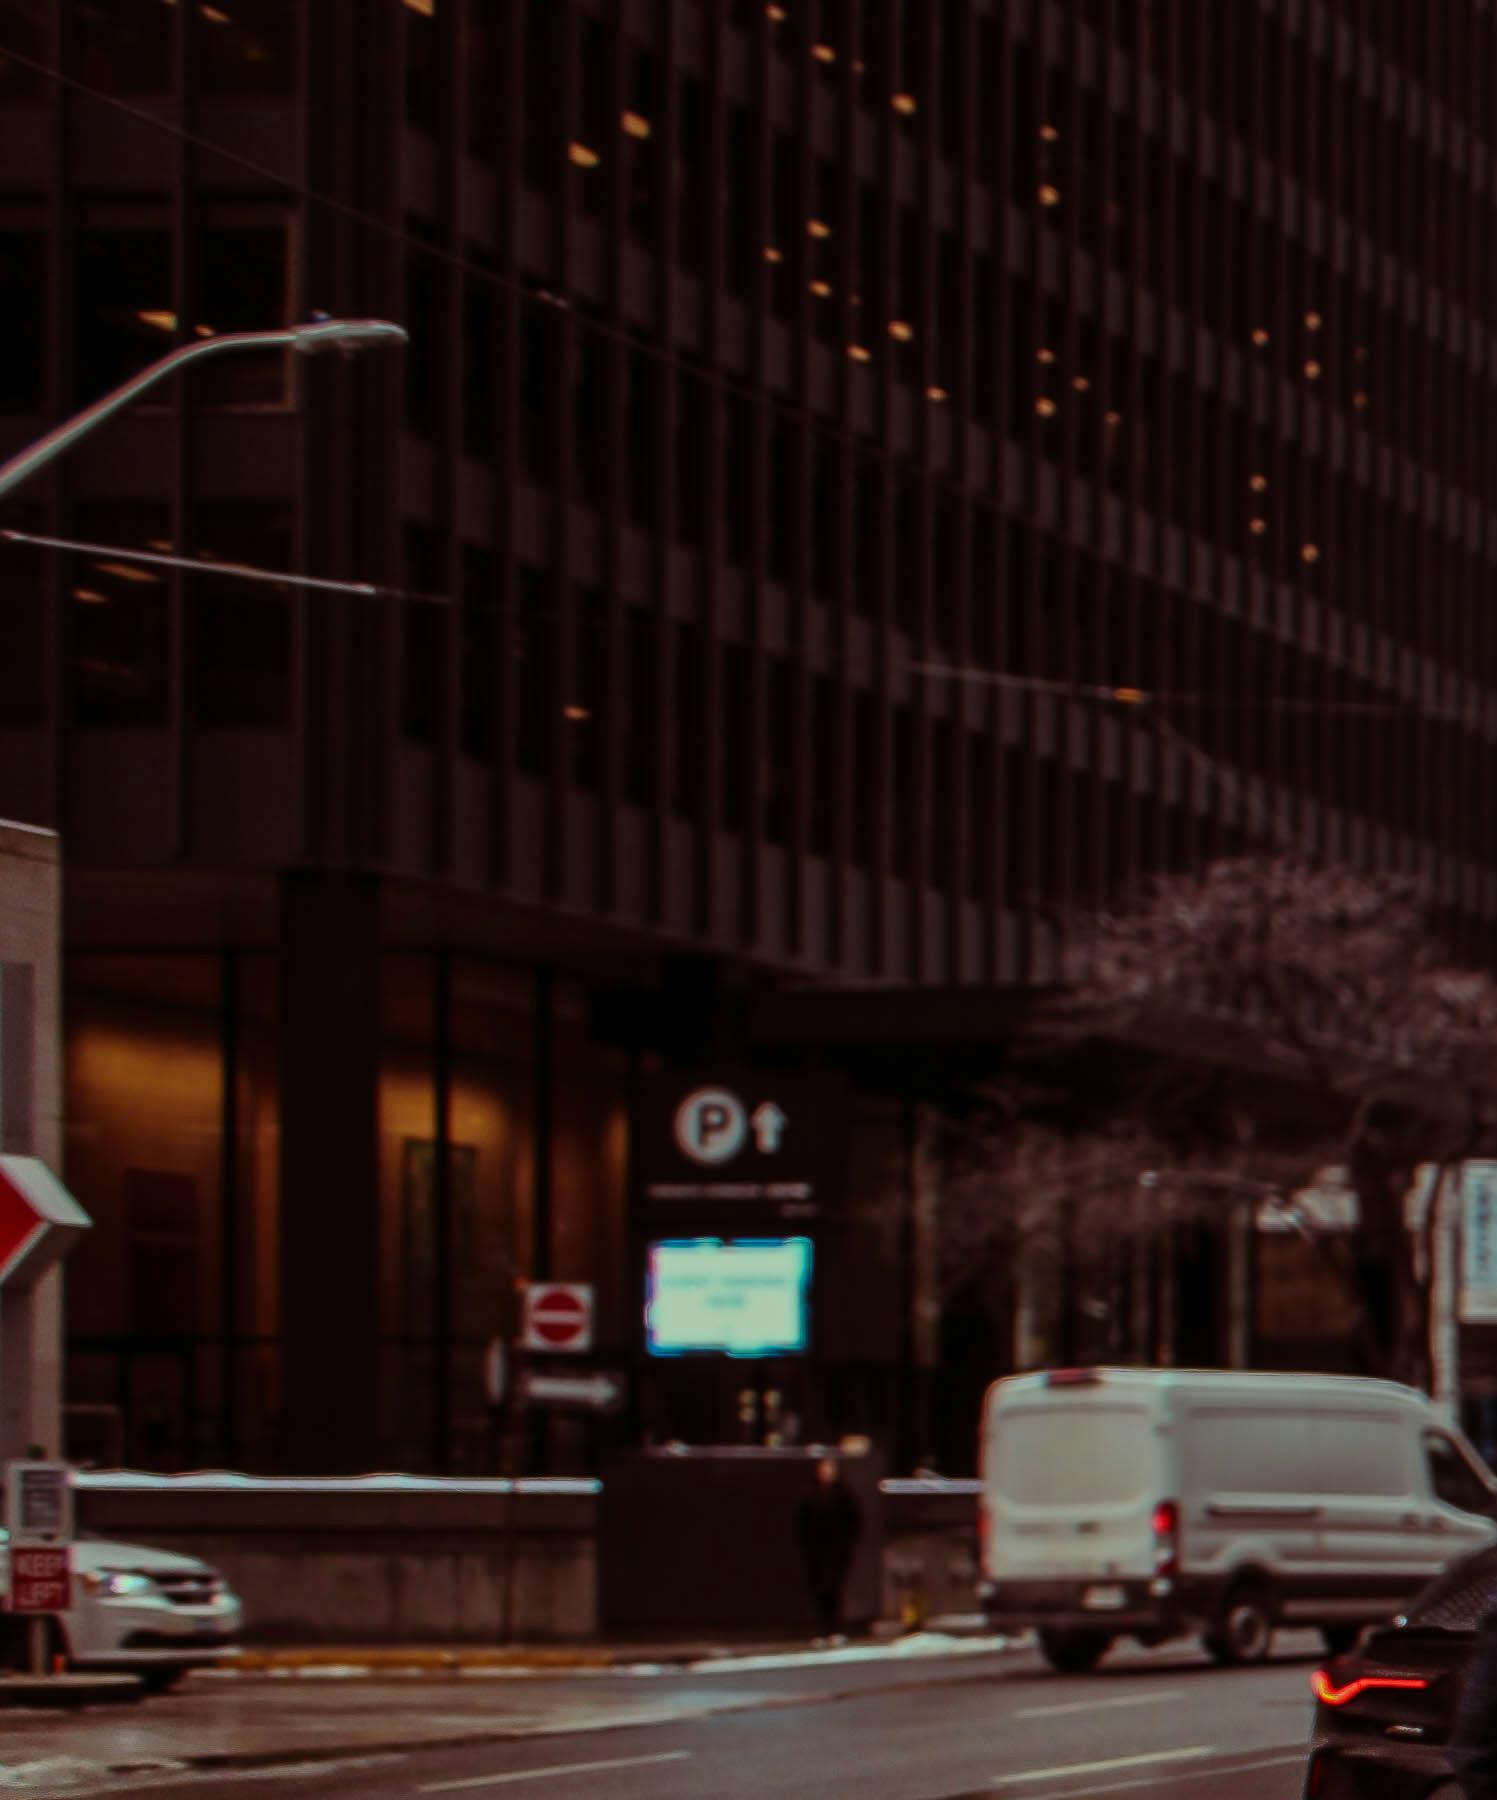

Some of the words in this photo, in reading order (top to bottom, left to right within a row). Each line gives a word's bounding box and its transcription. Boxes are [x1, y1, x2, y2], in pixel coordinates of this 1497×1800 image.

[697, 1103, 732, 1148] P
[17, 1554, 63, 1577] KEEP
[17, 1582, 64, 1605] LEFT
